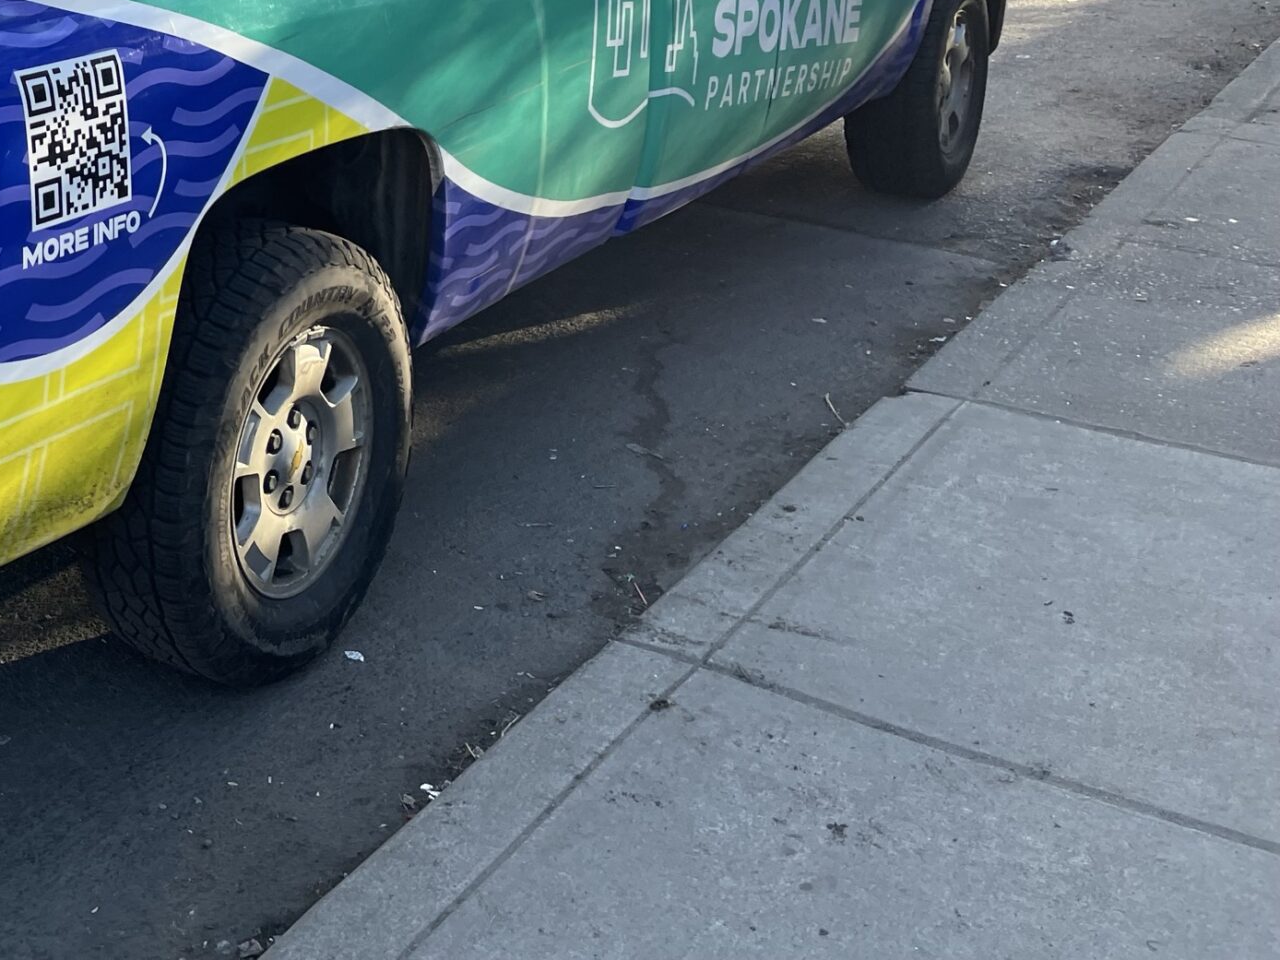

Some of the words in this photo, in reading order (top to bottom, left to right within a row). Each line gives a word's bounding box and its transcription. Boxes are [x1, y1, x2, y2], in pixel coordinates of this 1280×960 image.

[705, 57, 853, 111] PARTNERSHIP
[22, 226, 90, 270] MORE
[93, 210, 142, 246] INFO
